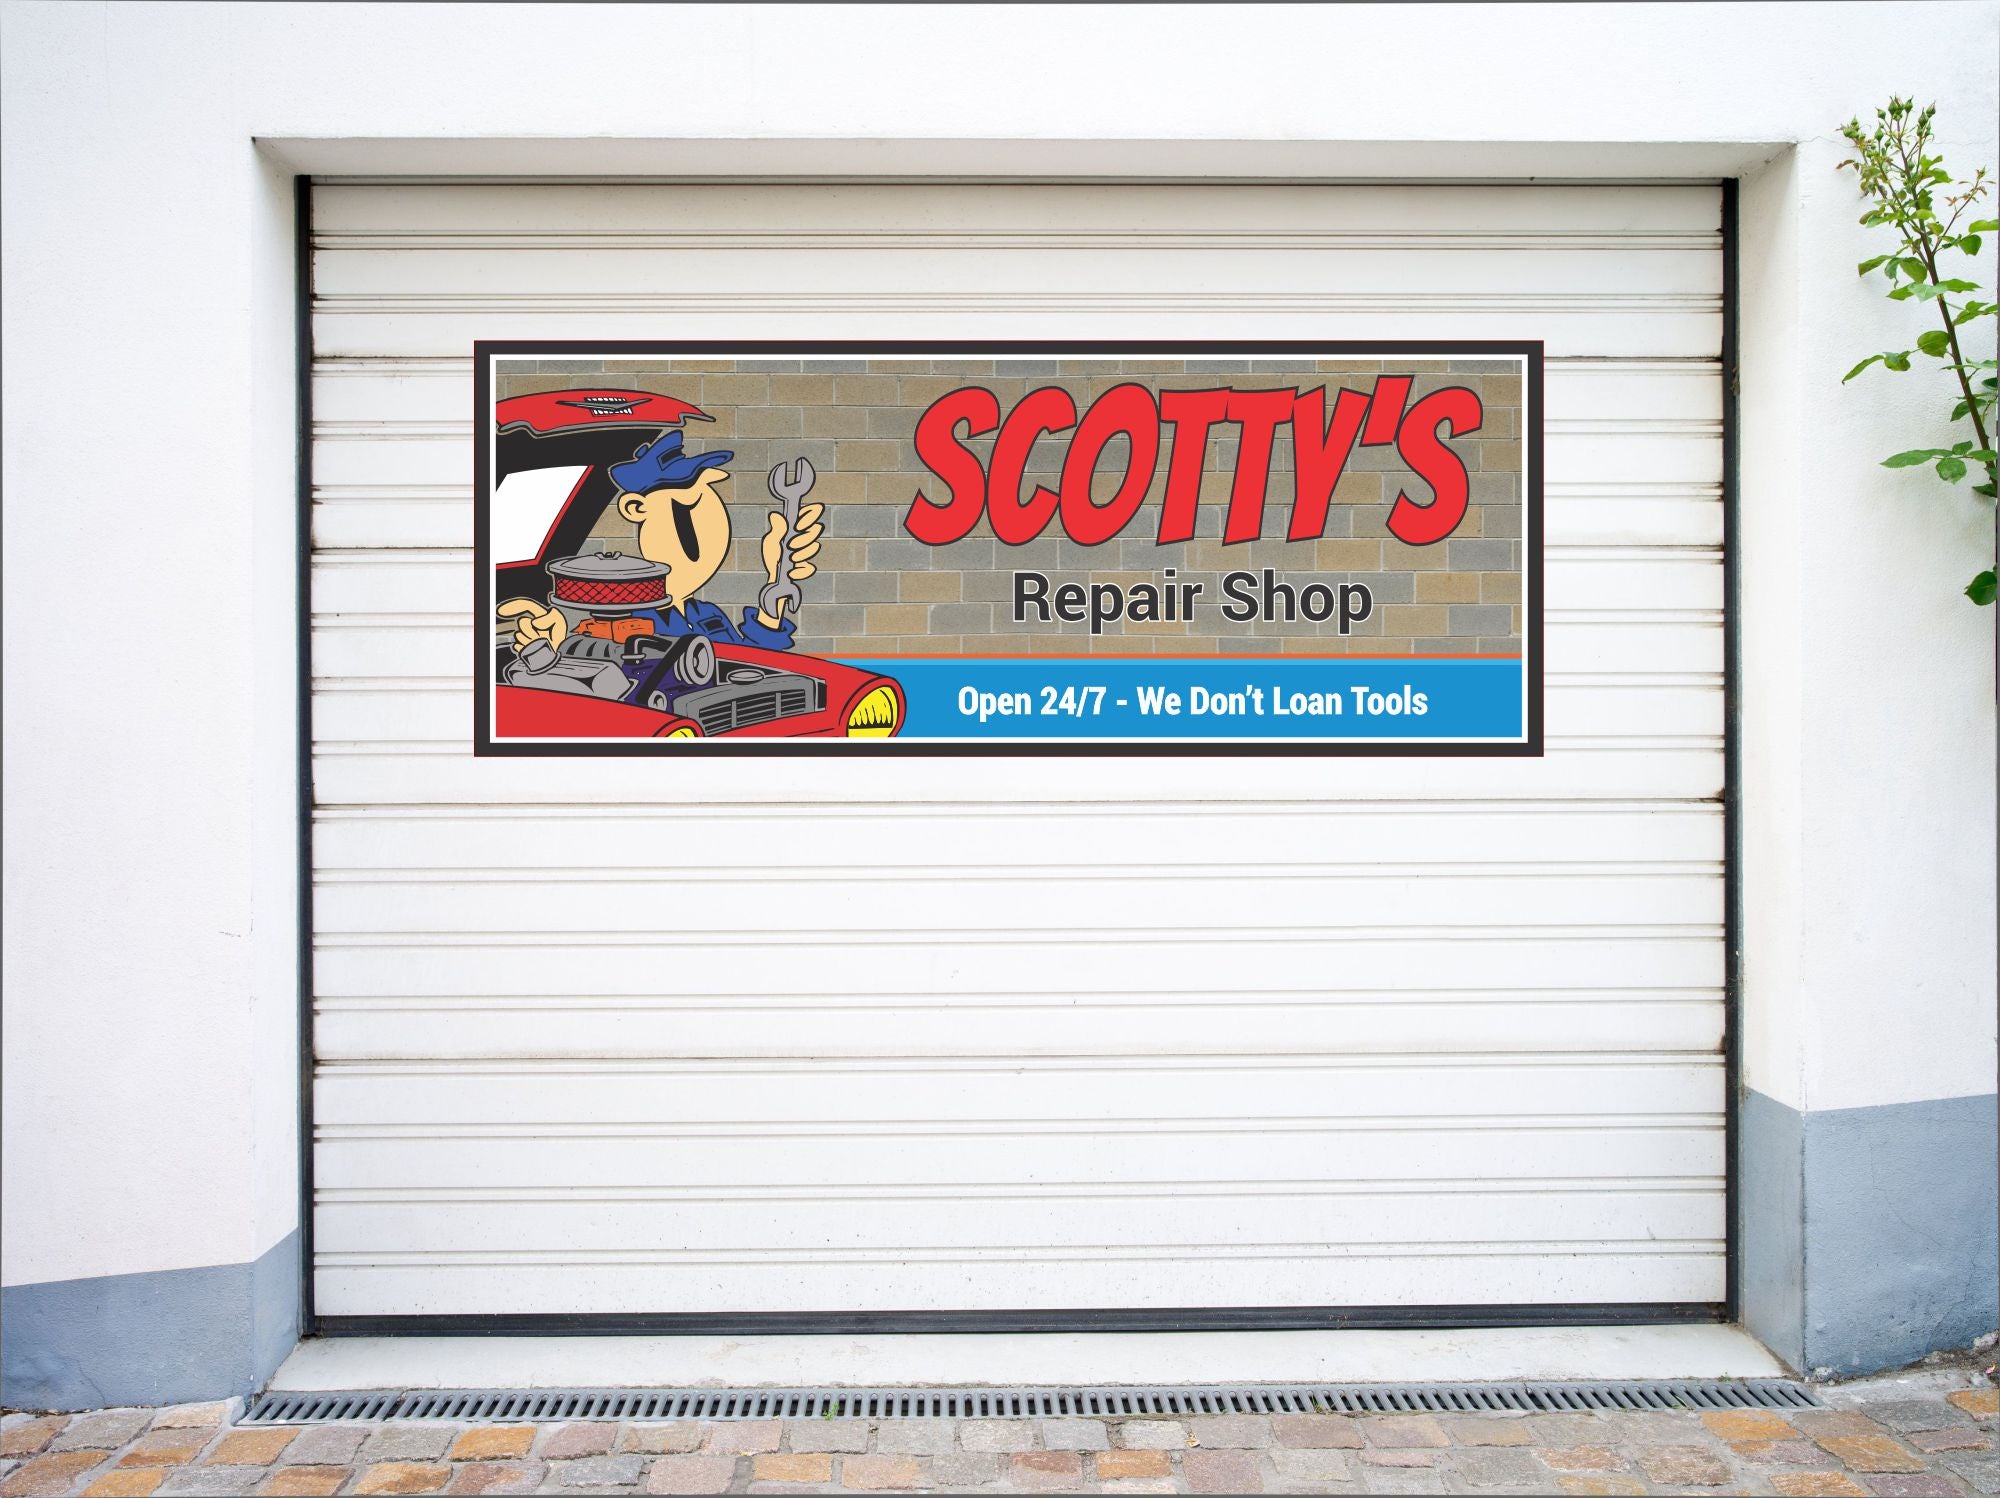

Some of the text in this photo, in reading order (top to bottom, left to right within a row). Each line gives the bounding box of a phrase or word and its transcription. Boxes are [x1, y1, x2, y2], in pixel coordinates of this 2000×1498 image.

[904, 375, 1483, 546] SCOTTY'S
[1013, 568, 1373, 635] Repair Shop
[957, 685, 1032, 723] Open
[1040, 685, 1107, 718] 24/7
[1136, 686, 1182, 716] We
[1190, 684, 1265, 716] Don’t
[1273, 686, 1343, 716] Loan
[1350, 684, 1428, 716] Tools
